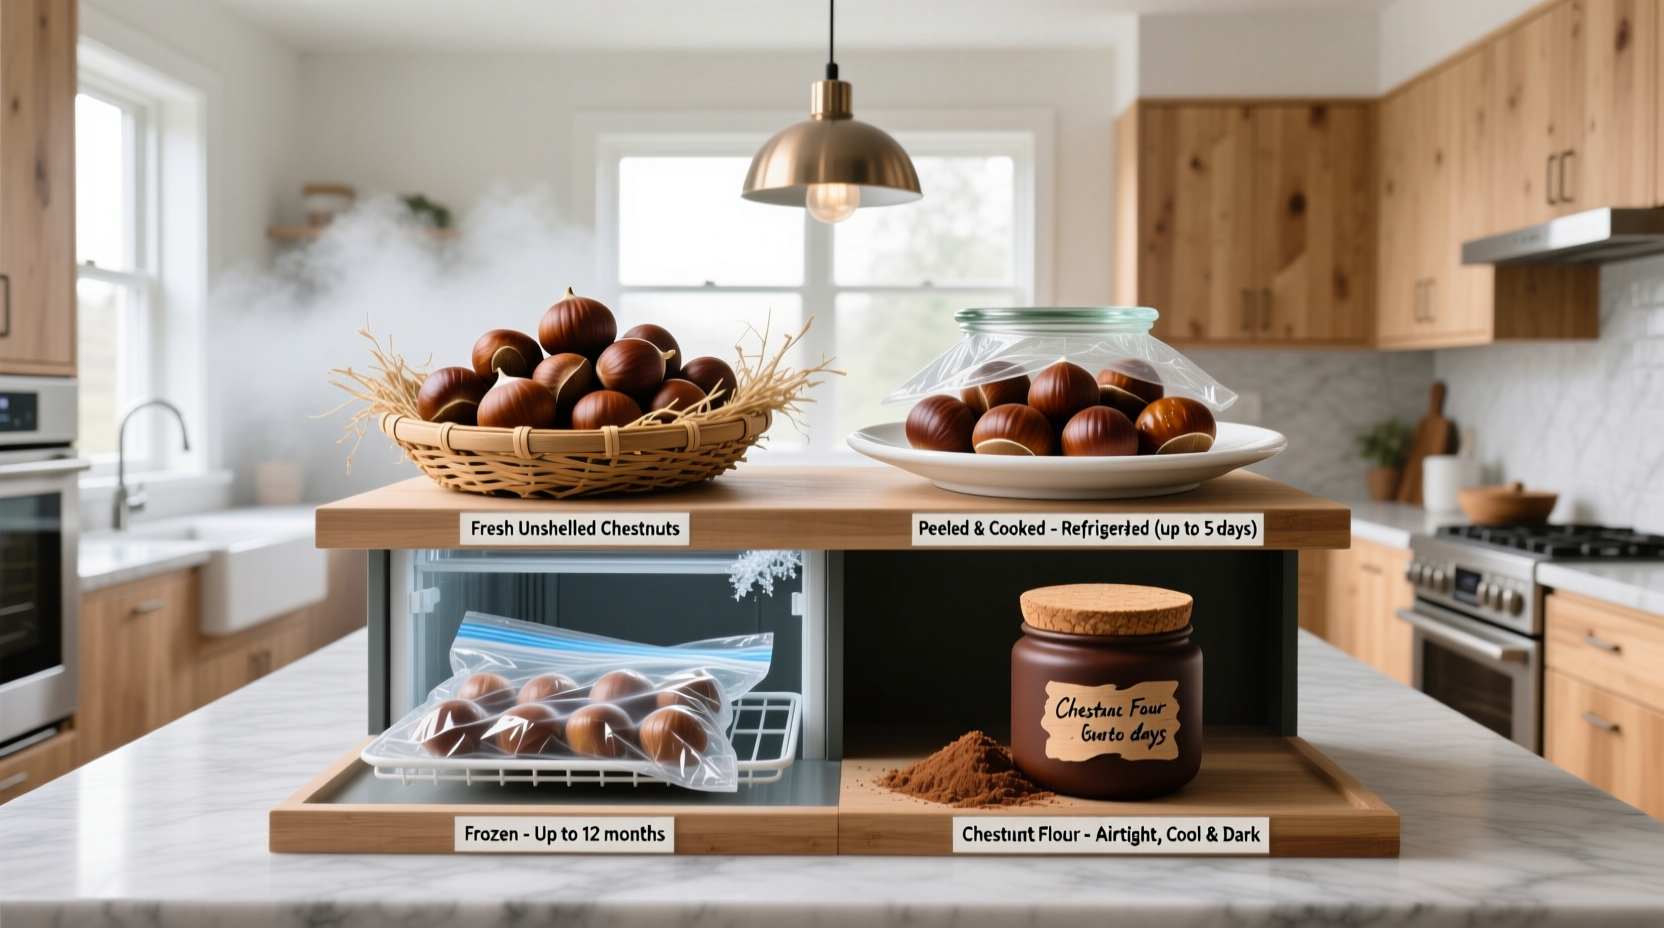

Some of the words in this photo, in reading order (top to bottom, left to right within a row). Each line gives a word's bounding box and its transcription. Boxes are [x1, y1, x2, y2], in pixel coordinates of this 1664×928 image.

[472, 519, 514, 537] Fresh
[518, 519, 596, 536] Unshelled
[600, 519, 681, 537] Chestnuts
[919, 519, 970, 536] Peeled
[973, 520, 985, 536] &
[988, 519, 1046, 537] Cooked
[1154, 518, 1180, 541] (up
[1184, 520, 1200, 537] to
[1204, 520, 1214, 537] 5
[1216, 519, 1258, 541] days)
[1130, 722, 1167, 750] days
[465, 825, 519, 842] Frozen
[534, 825, 558, 846] Up
[560, 826, 578, 842] to
[583, 825, 600, 842] 12
[604, 824, 666, 842] months
[1038, 825, 1081, 842] Flour
[1095, 825, 1162, 847] Airtight,
[1166, 825, 1202, 843] Cool
[1205, 825, 1219, 843] &
[1222, 825, 1261, 843] Dark
